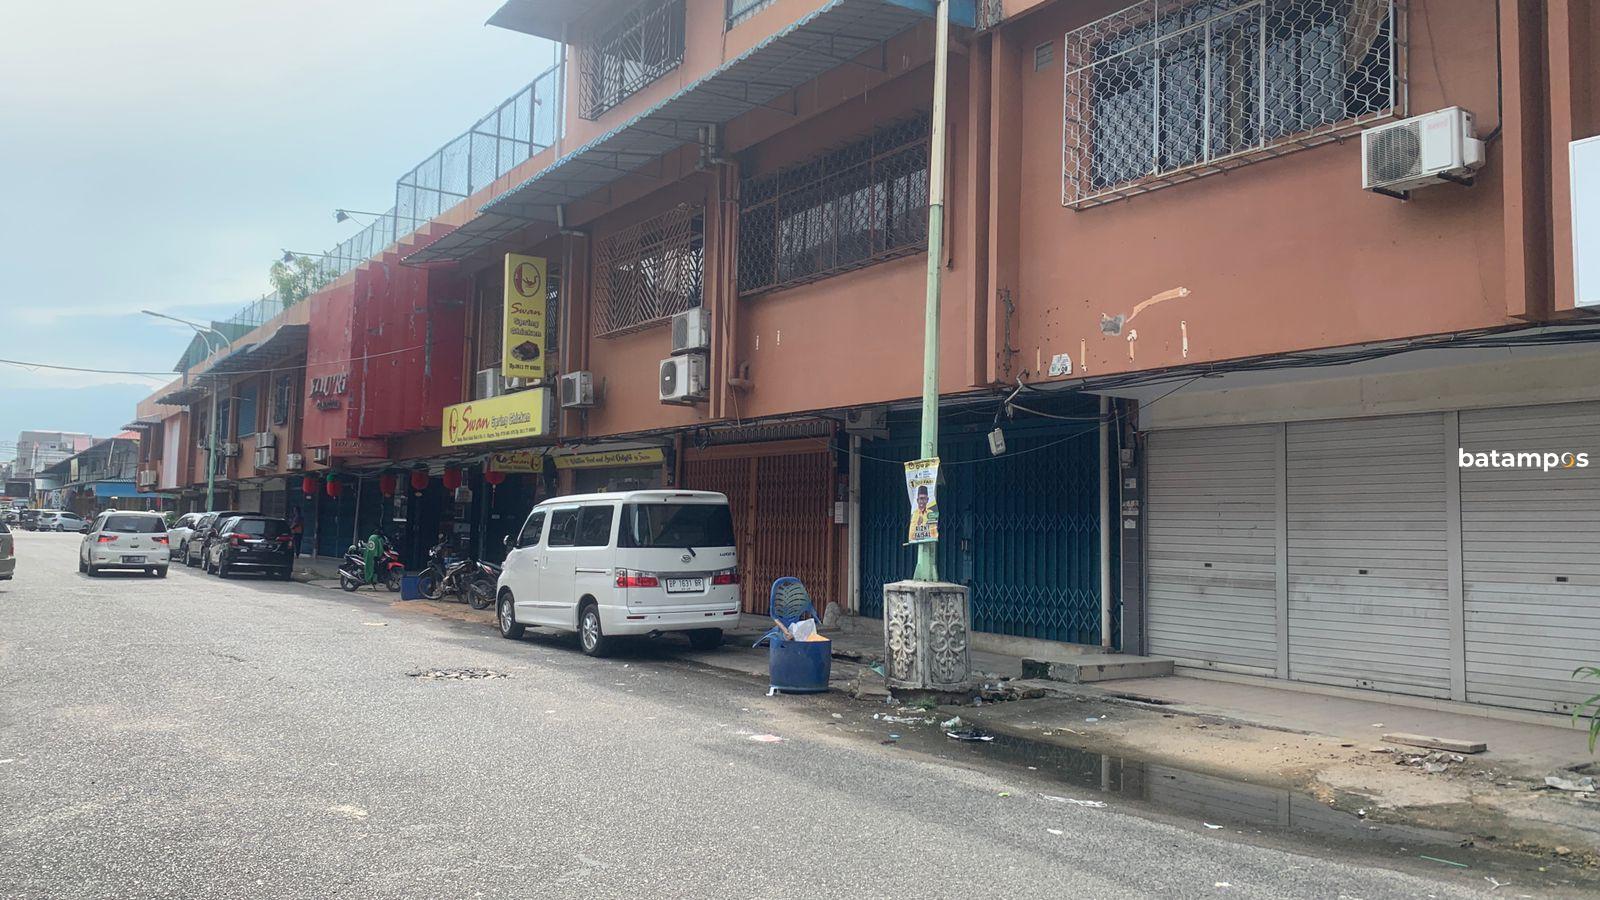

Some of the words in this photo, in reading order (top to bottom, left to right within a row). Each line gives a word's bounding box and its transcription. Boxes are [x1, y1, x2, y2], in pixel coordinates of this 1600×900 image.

[511, 302, 542, 316] Swan
[513, 317, 540, 329] Spring
[510, 327, 542, 338] Chicken
[461, 405, 490, 436] Swan
[491, 415, 509, 430] Spring
[509, 411, 531, 425] Chicken
[669, 579, 677, 588] BP
[679, 579, 692, 588] 1631
